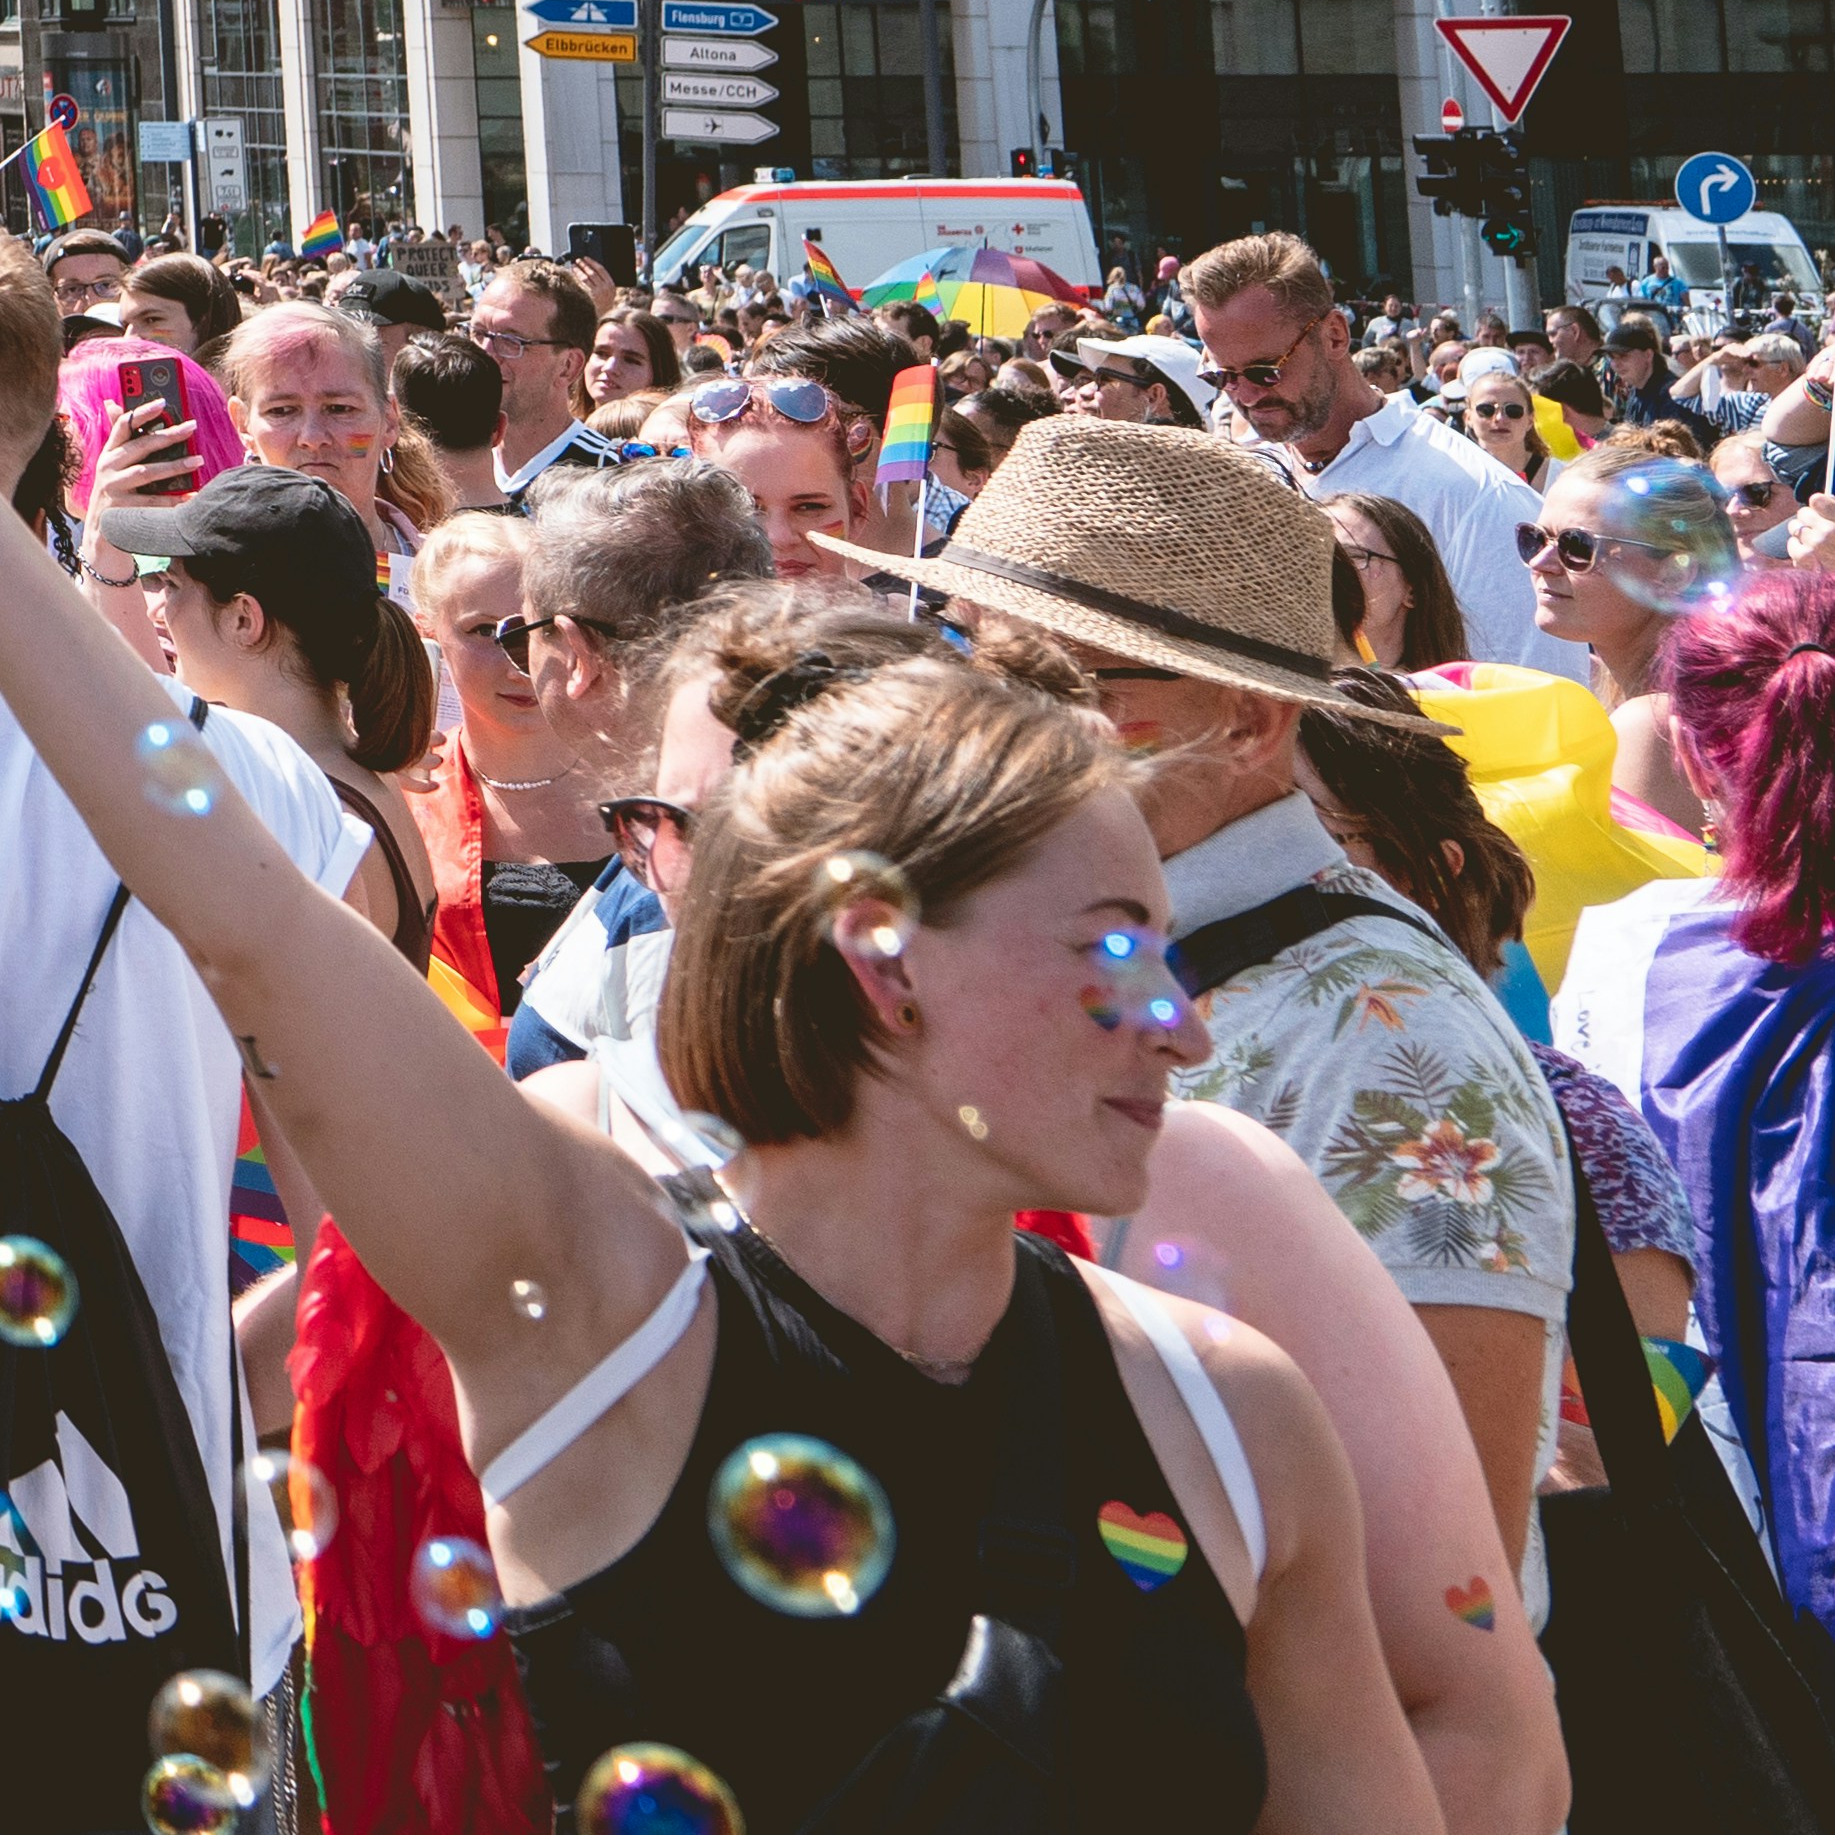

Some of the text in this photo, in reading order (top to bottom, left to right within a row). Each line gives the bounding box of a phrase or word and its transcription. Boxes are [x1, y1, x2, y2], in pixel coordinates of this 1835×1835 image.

[671, 9, 725, 29] Flensburg
[545, 37, 628, 55] Elbbrücken
[690, 46, 737, 62] Altona
[670, 81, 757, 99] Messe/CCH
[397, 246, 457, 262] PROTECT
[406, 263, 447, 277] QUEER
